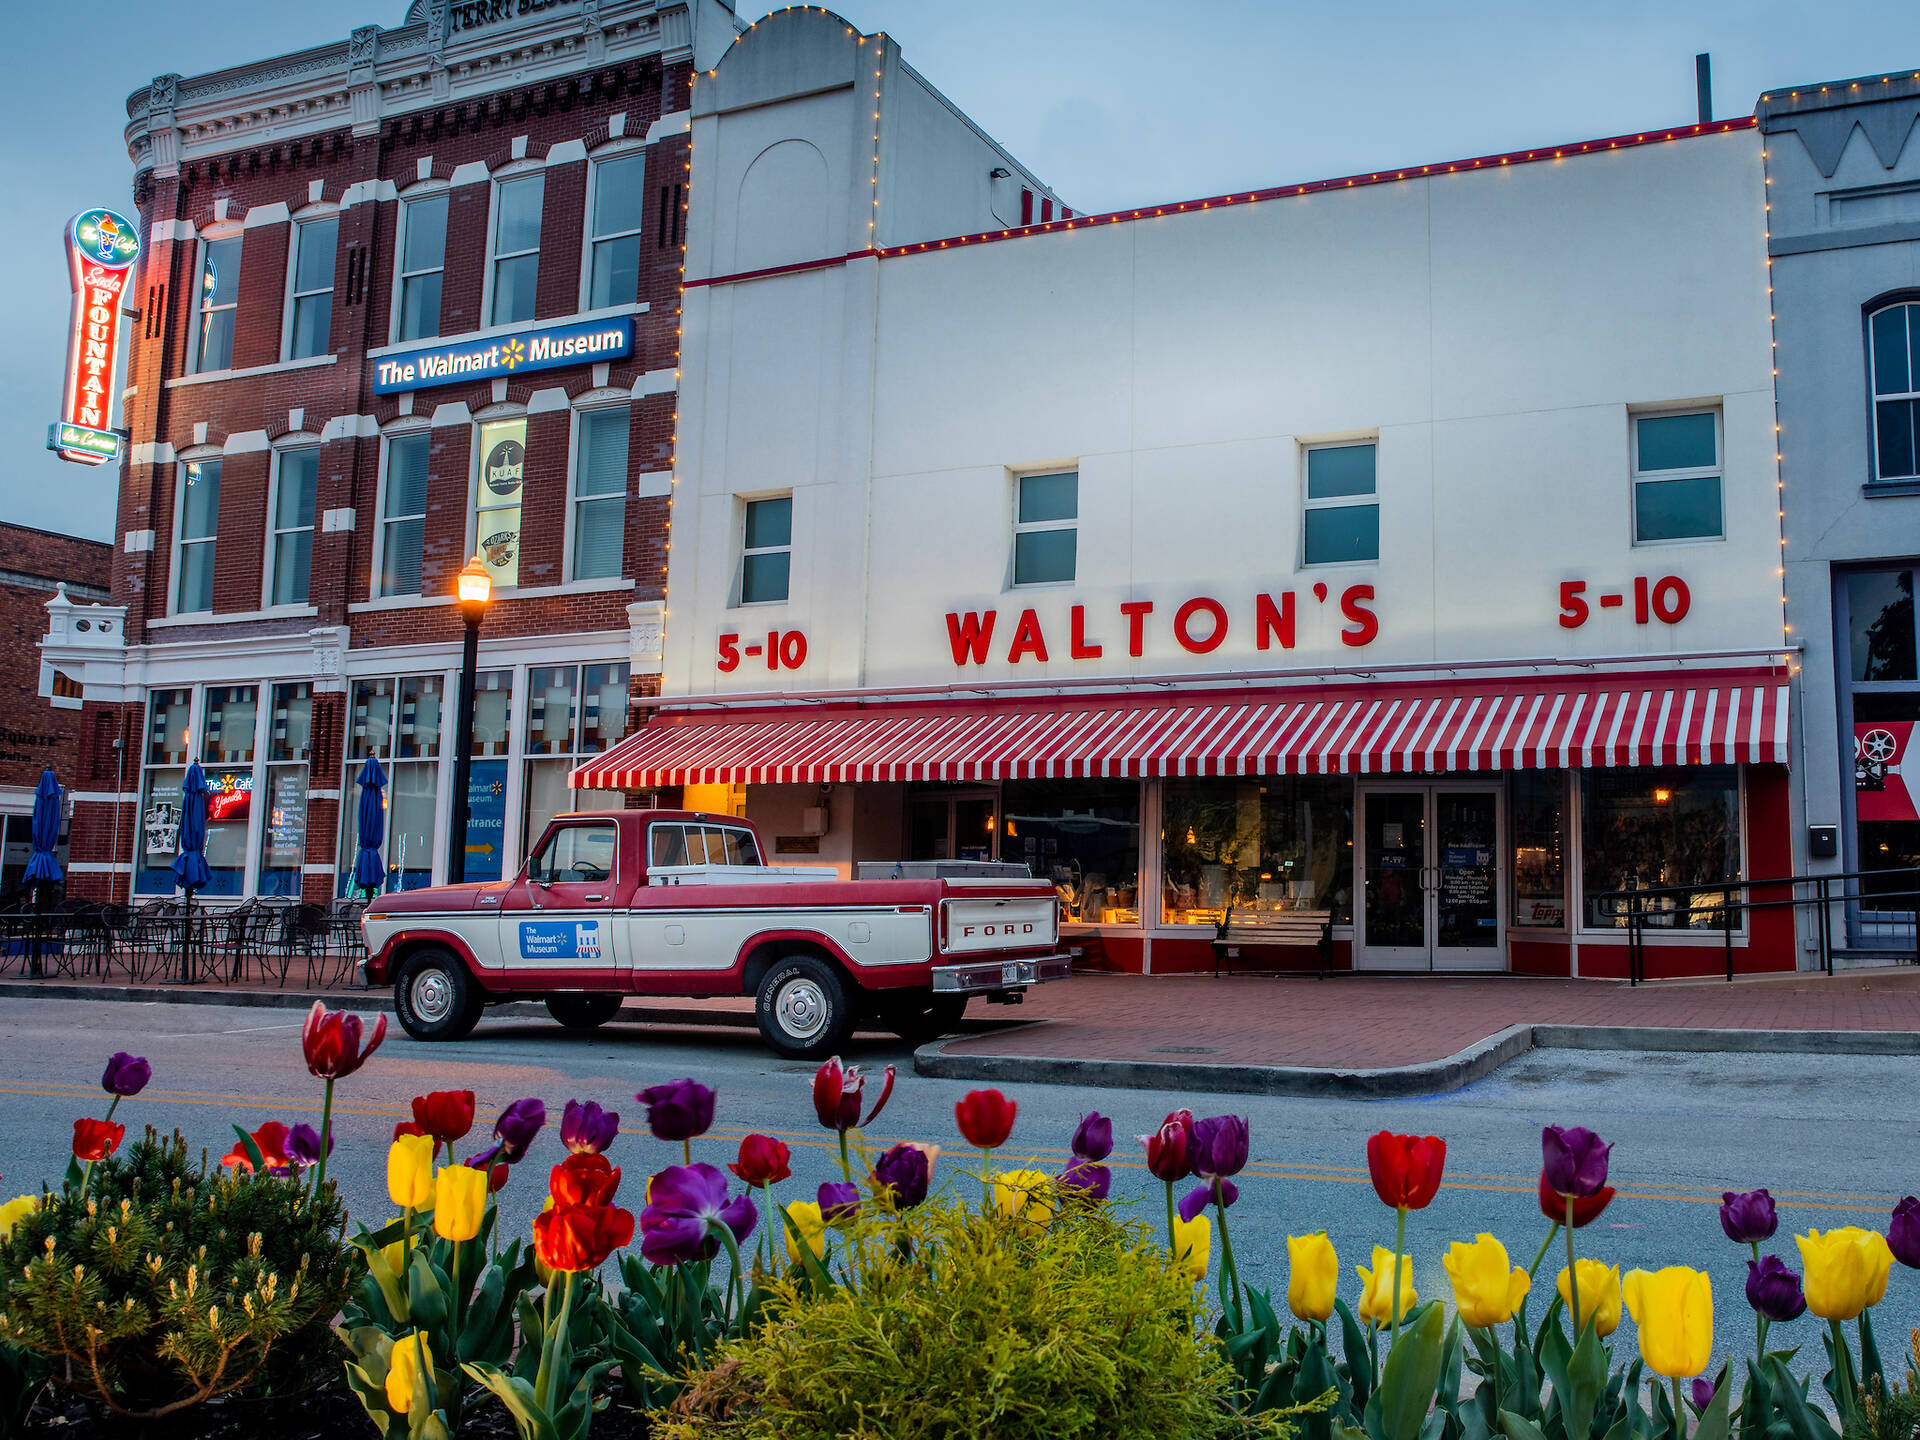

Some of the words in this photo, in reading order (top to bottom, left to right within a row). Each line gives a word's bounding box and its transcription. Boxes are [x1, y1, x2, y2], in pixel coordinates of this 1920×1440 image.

[450, 0, 512, 32] TERRY
[84, 266, 122, 293] Soda
[79, 288, 113, 426] FOUNTAIN
[378, 361, 414, 385] The
[419, 346, 499, 378] Walmart
[529, 330, 623, 362] Museum
[493, 467, 520, 478] KUAF
[1559, 576, 1691, 628] 5-10
[946, 582, 1379, 666] WALTON'S
[717, 630, 807, 673] 5-10
[206, 780, 220, 790] The
[468, 784, 492, 792] almart
[467, 818, 502, 828] ntrance
[526, 935, 557, 944] Walmart
[964, 923, 1033, 937] FORD
[527, 945, 558, 954] Museum
[763, 968, 800, 1012] GENERAL
